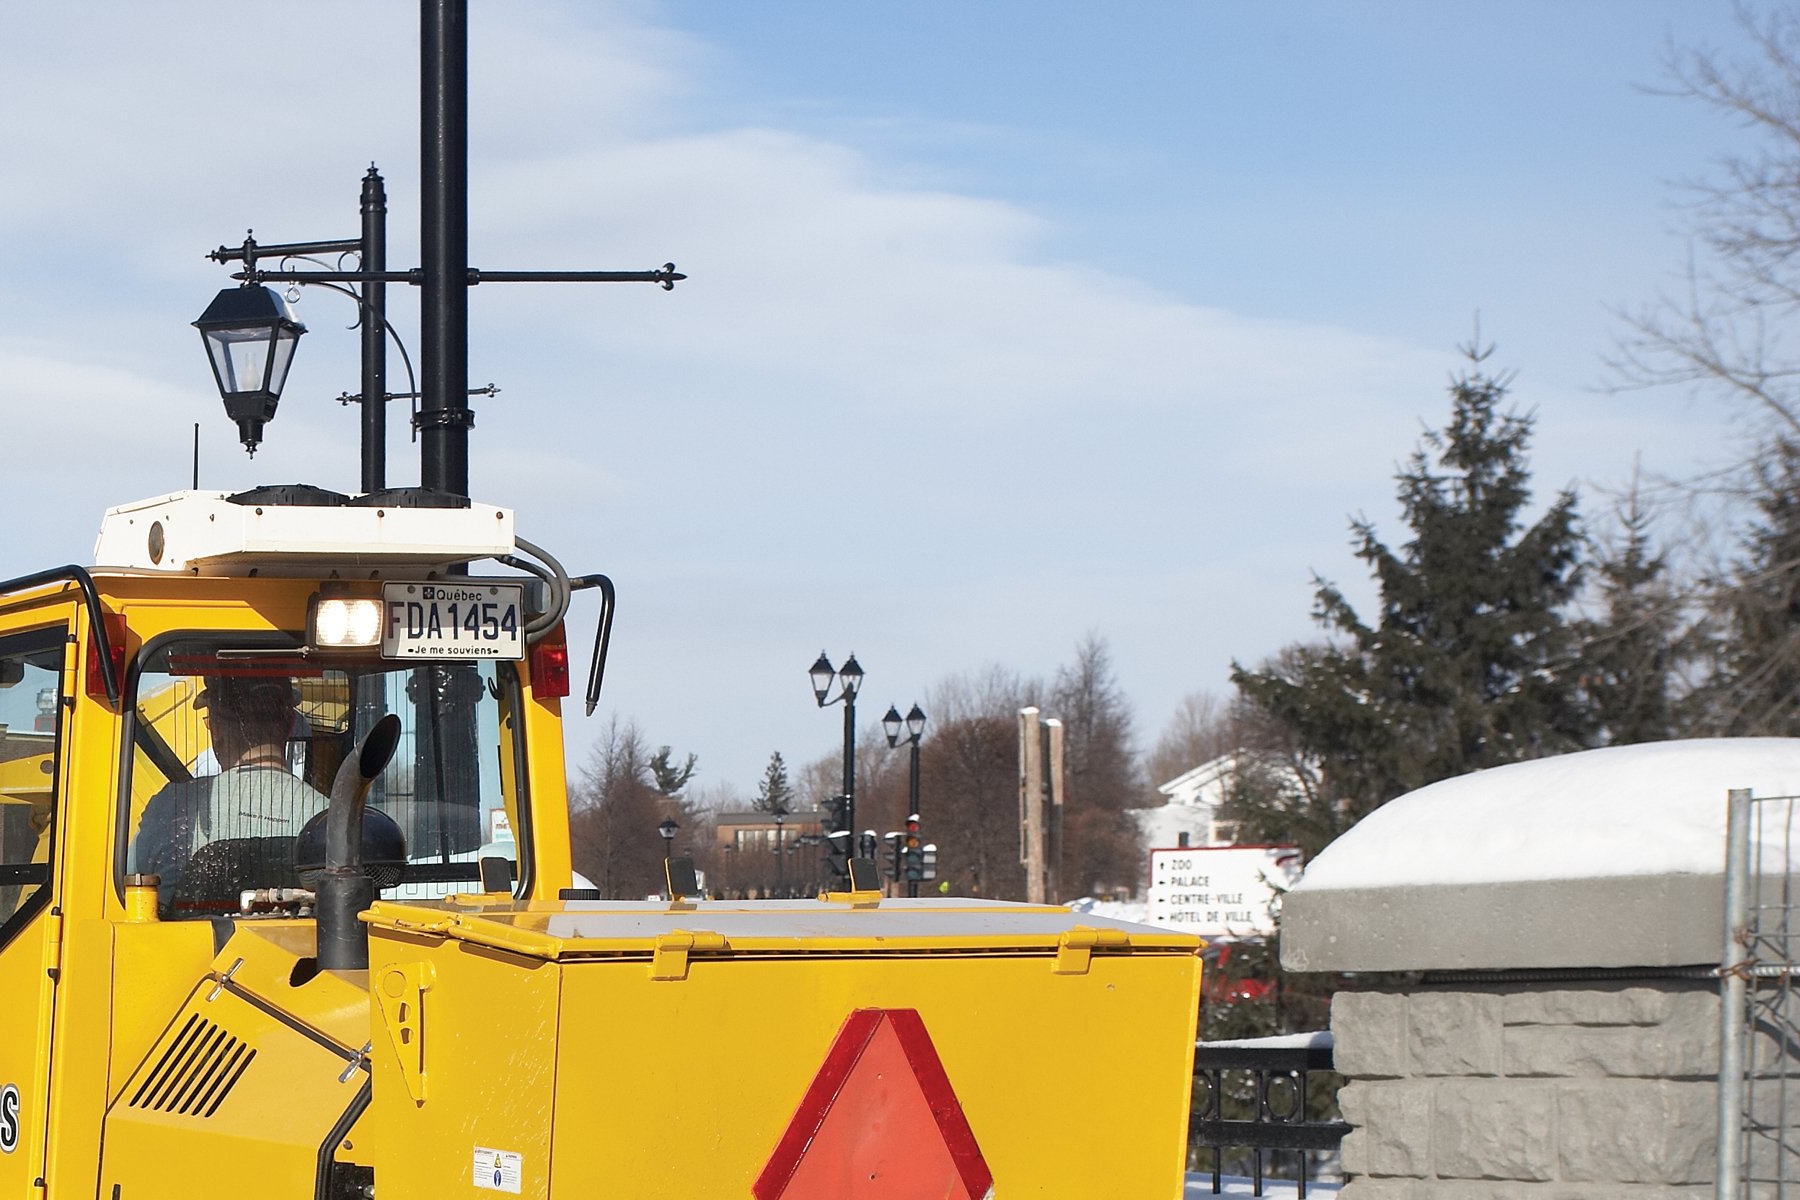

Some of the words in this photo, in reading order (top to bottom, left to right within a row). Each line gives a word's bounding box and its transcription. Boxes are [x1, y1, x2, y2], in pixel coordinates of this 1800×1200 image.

[436, 588, 482, 600] Québec
[387, 601, 518, 641] FDA1454
[414, 645, 426, 654] Je
[448, 645, 492, 655] souviens
[1171, 859, 1192, 870] ZOO
[1171, 876, 1210, 887] PALACE
[1170, 892, 1242, 905] CENTRE-VILLE
[1207, 911, 1218, 922] DE
[1225, 911, 1252, 922] VILLE
